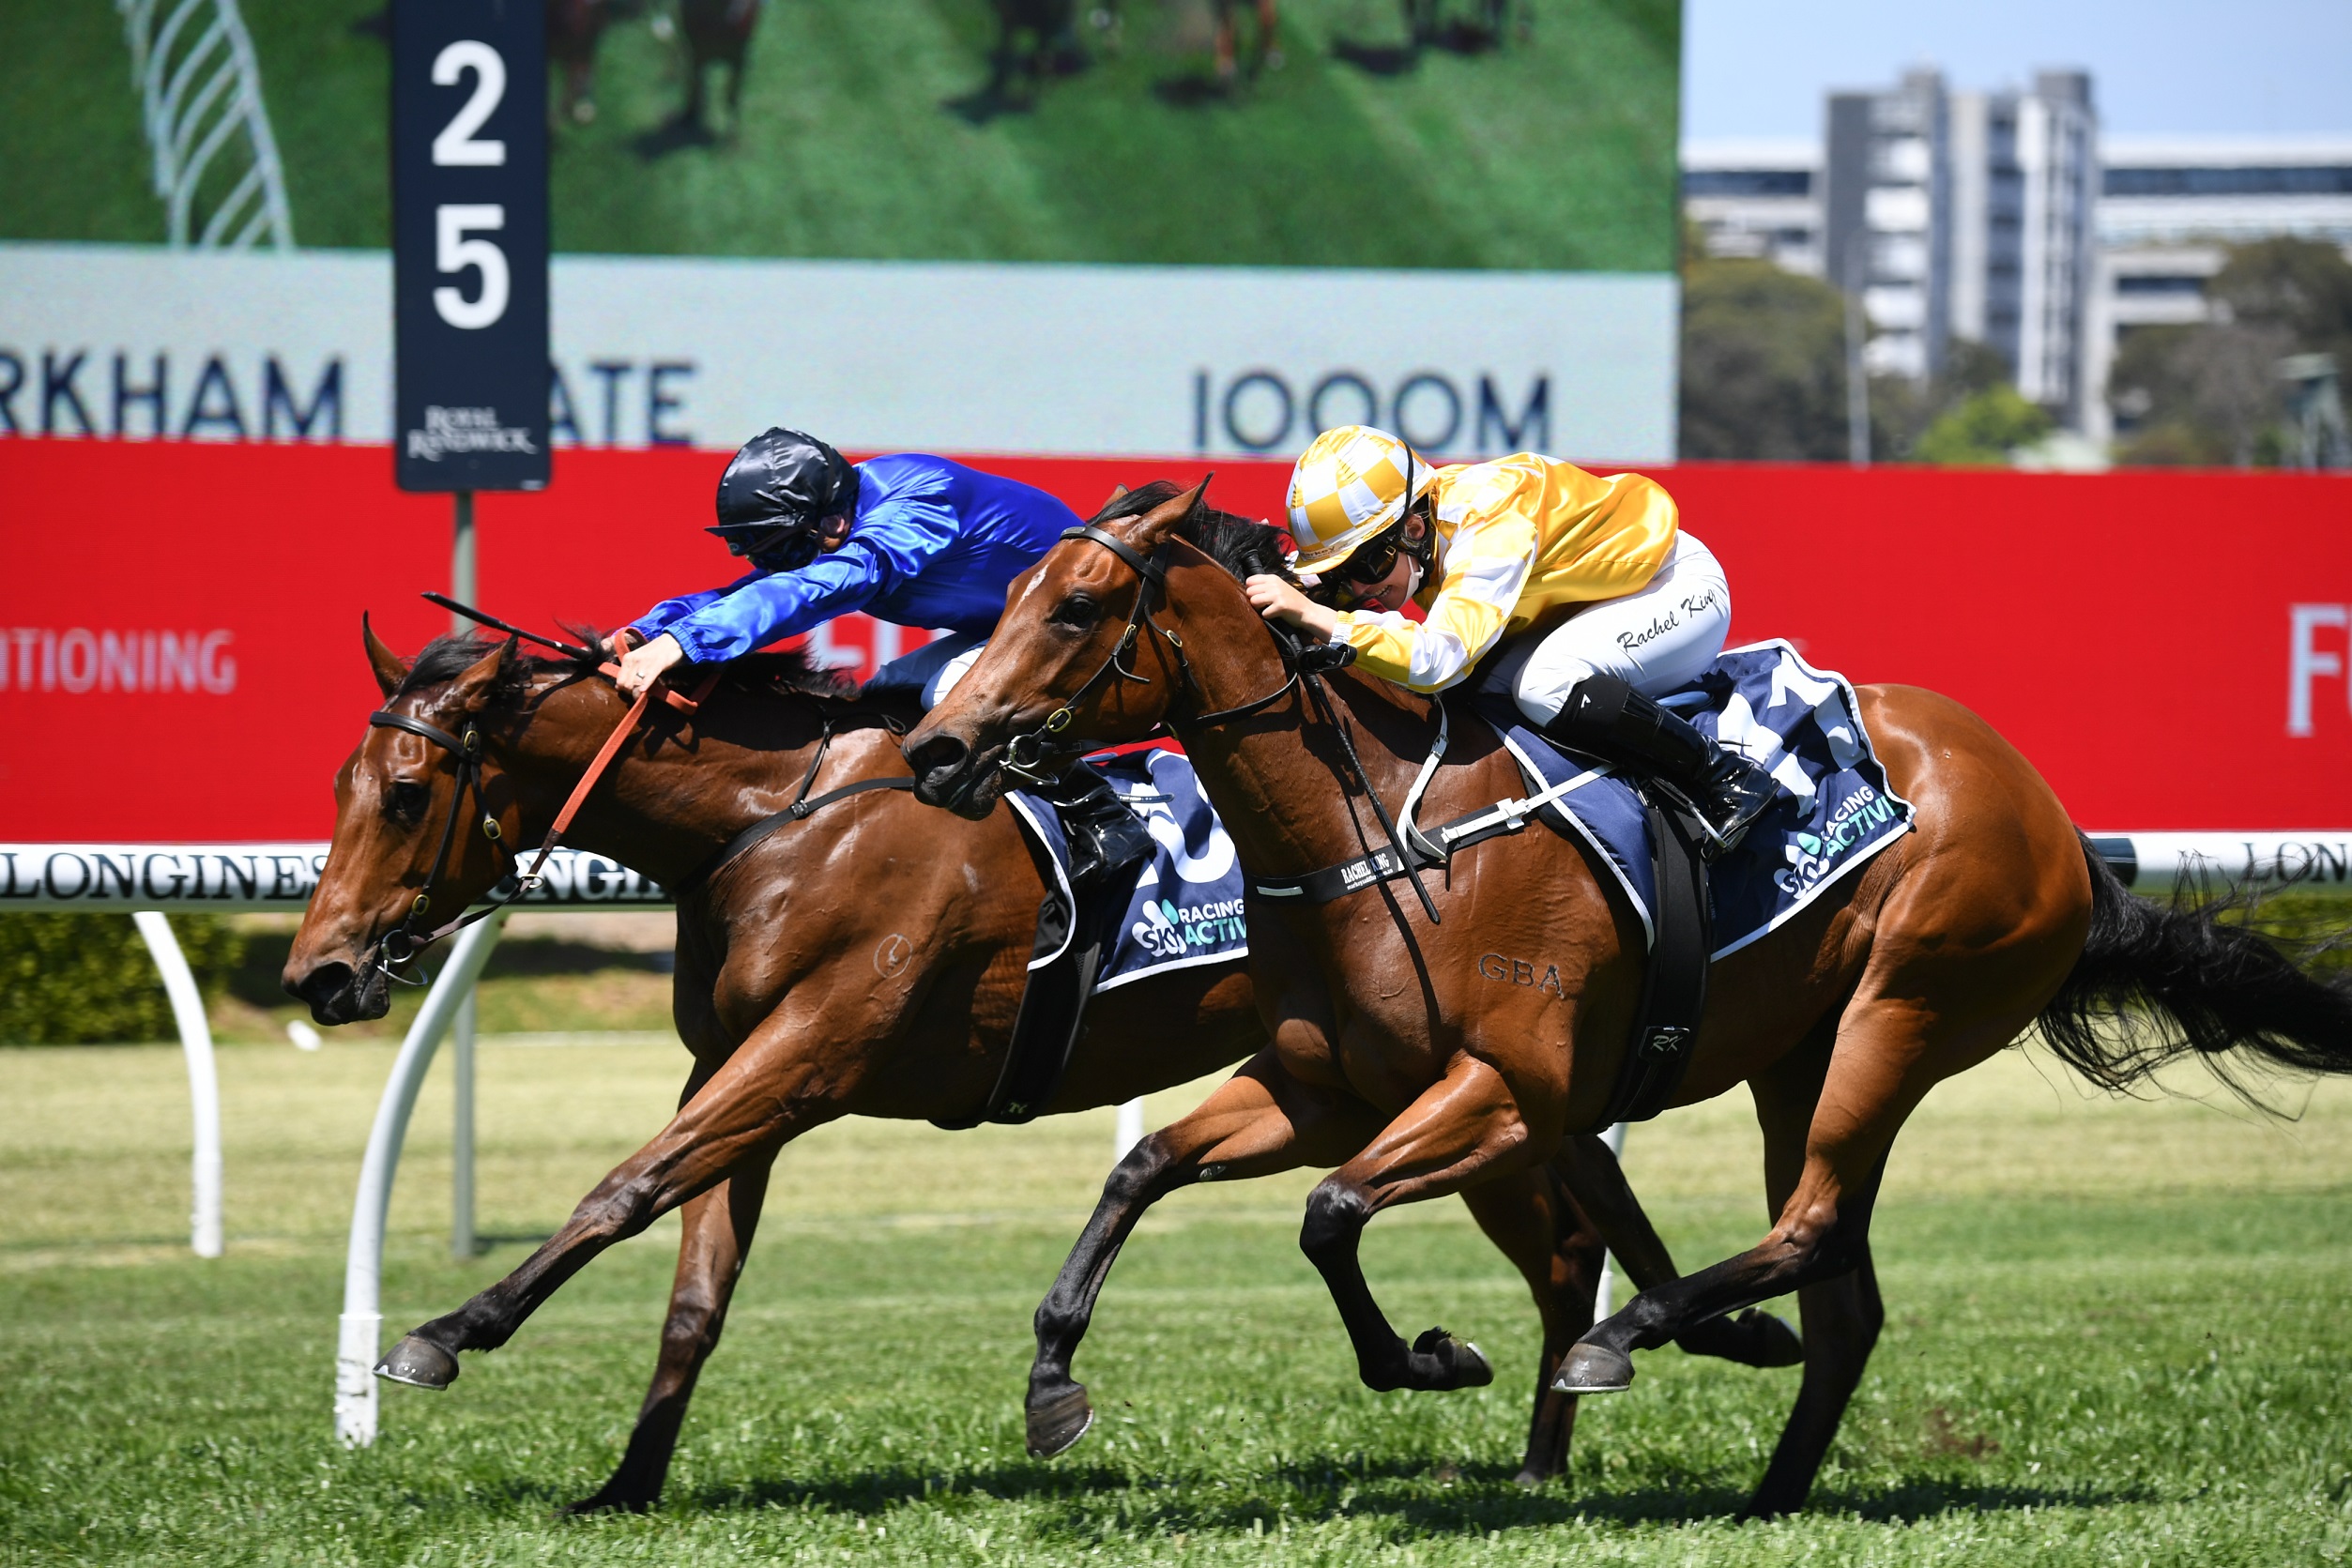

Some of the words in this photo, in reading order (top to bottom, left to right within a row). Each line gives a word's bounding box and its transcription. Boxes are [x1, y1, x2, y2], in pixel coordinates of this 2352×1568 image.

[432, 39, 507, 166] 2
[434, 204, 511, 329] 5
[425, 404, 498, 436] ROYAL
[407, 427, 540, 462] RANDWICK
[1616, 611, 1680, 653] Rachel
[1340, 860, 1372, 884] RACHEL
[1369, 852, 1390, 873] KING
[1177, 898, 1245, 924] RACING
[1477, 952, 1565, 1000] GBA
[1650, 1034, 1684, 1053] RK
